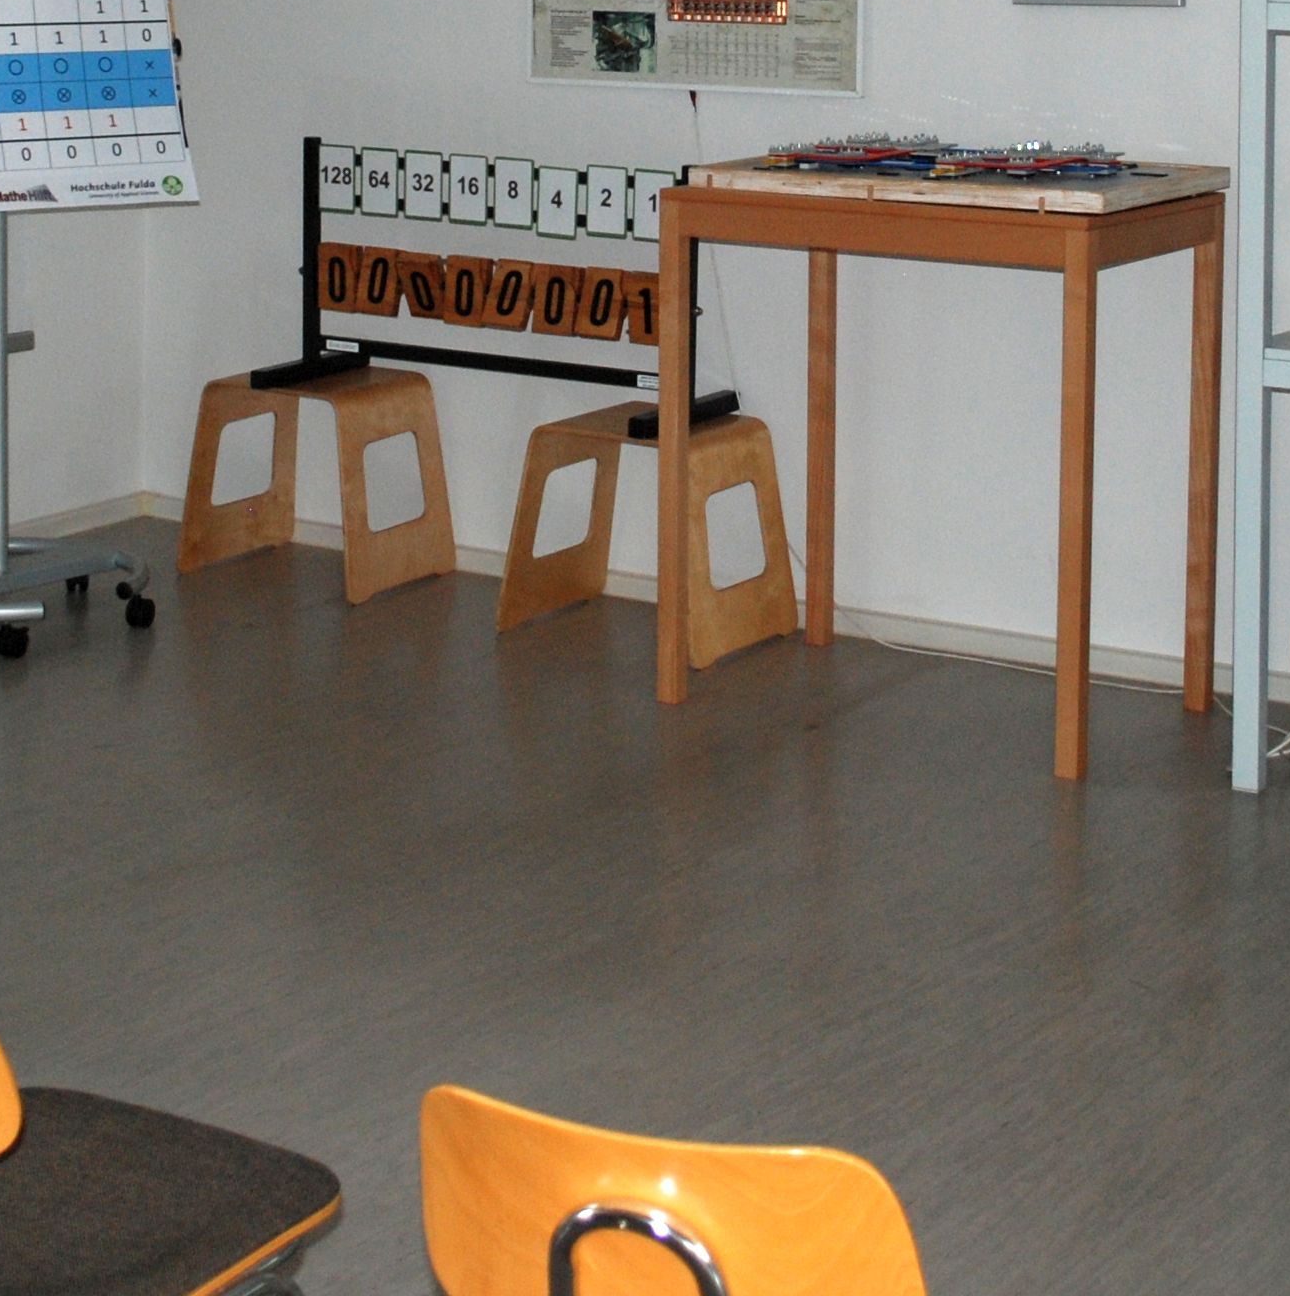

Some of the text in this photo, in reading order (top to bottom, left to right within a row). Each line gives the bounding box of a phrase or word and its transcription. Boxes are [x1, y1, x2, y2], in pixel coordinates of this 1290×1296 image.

[97, 0, 105, 14] 1
[141, 0, 149, 13] 1
[10, 29, 152, 46] 1 1 1 0
[19, 118, 27, 131] 1
[64, 116, 72, 130] 1
[109, 114, 117, 128] 1
[21, 147, 32, 161] 0
[67, 145, 77, 159] 0
[112, 143, 122, 157] 0
[156, 140, 166, 154] 0
[70, 179, 156, 193] Hochschule Fulda
[320, 167, 657, 212] 128 64 32 16 8 4 2 1
[327, 256, 653, 335] 0 0 0 0 0 0 0 1
